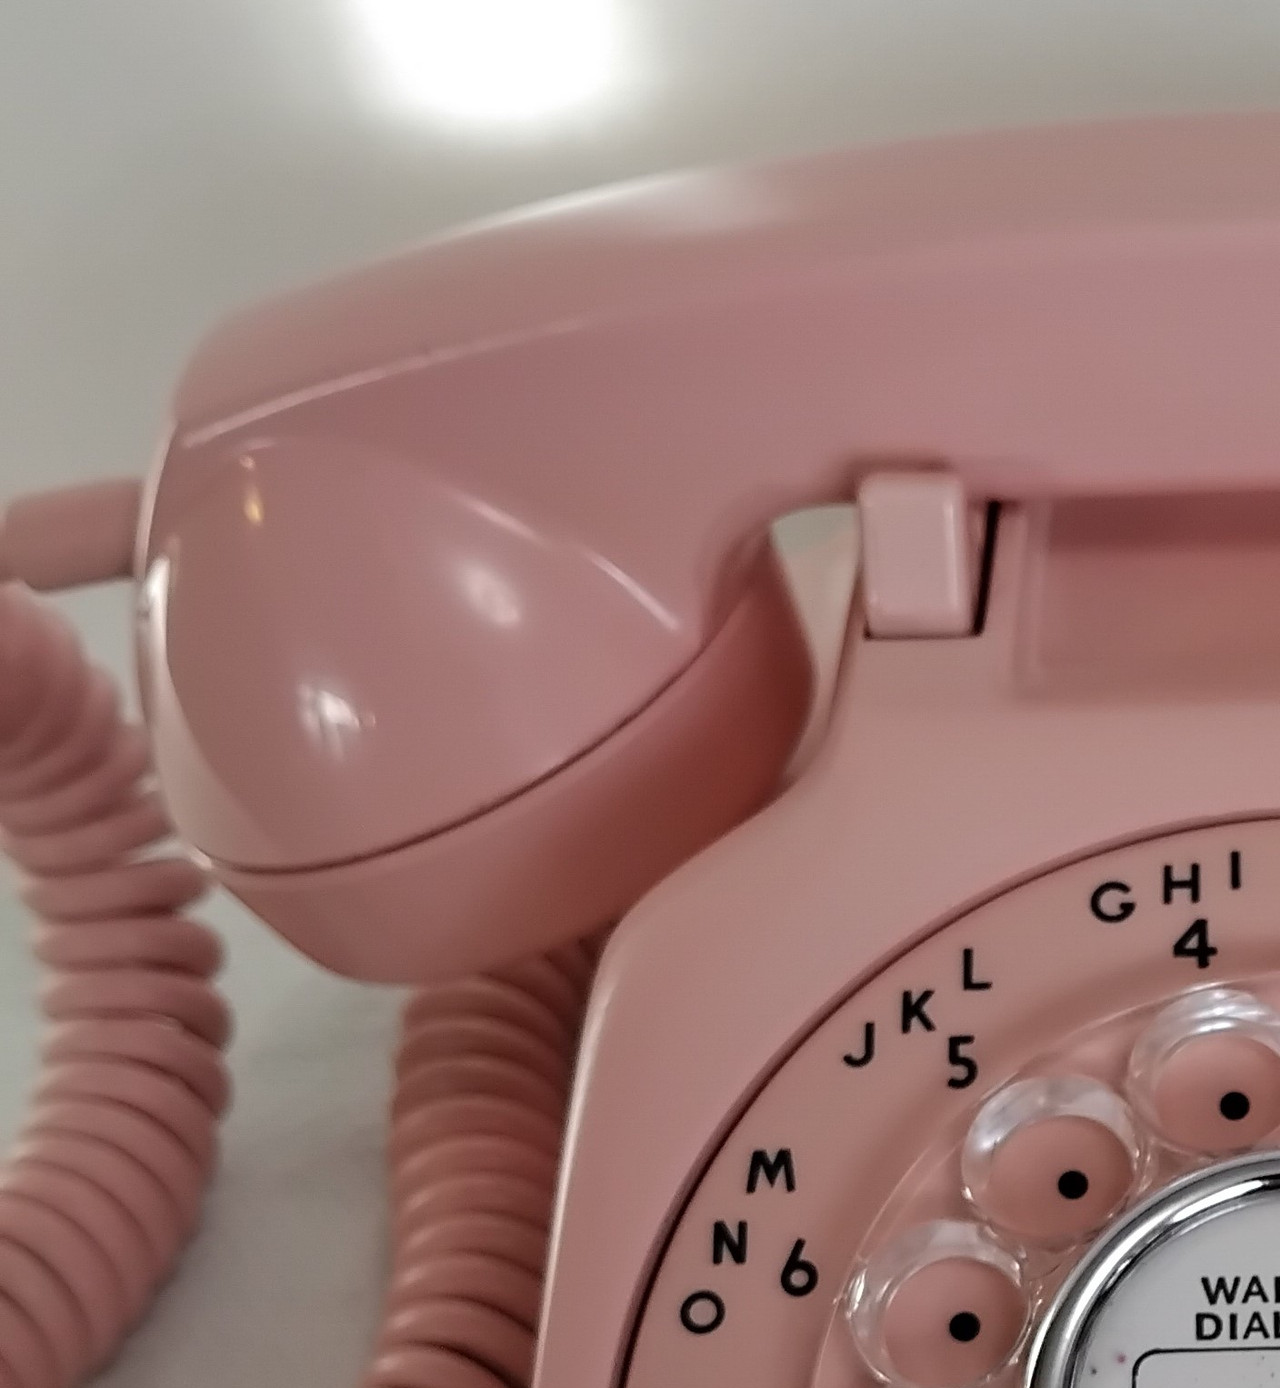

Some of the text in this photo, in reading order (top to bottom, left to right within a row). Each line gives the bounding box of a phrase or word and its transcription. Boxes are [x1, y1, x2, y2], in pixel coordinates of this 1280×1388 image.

[1088, 849, 1243, 925] G H I
[1170, 916, 1220, 971] 4
[841, 946, 994, 1070] J K L
[944, 1033, 980, 1092] 5
[677, 1146, 798, 1338] M N O
[778, 1235, 821, 1300] 6
